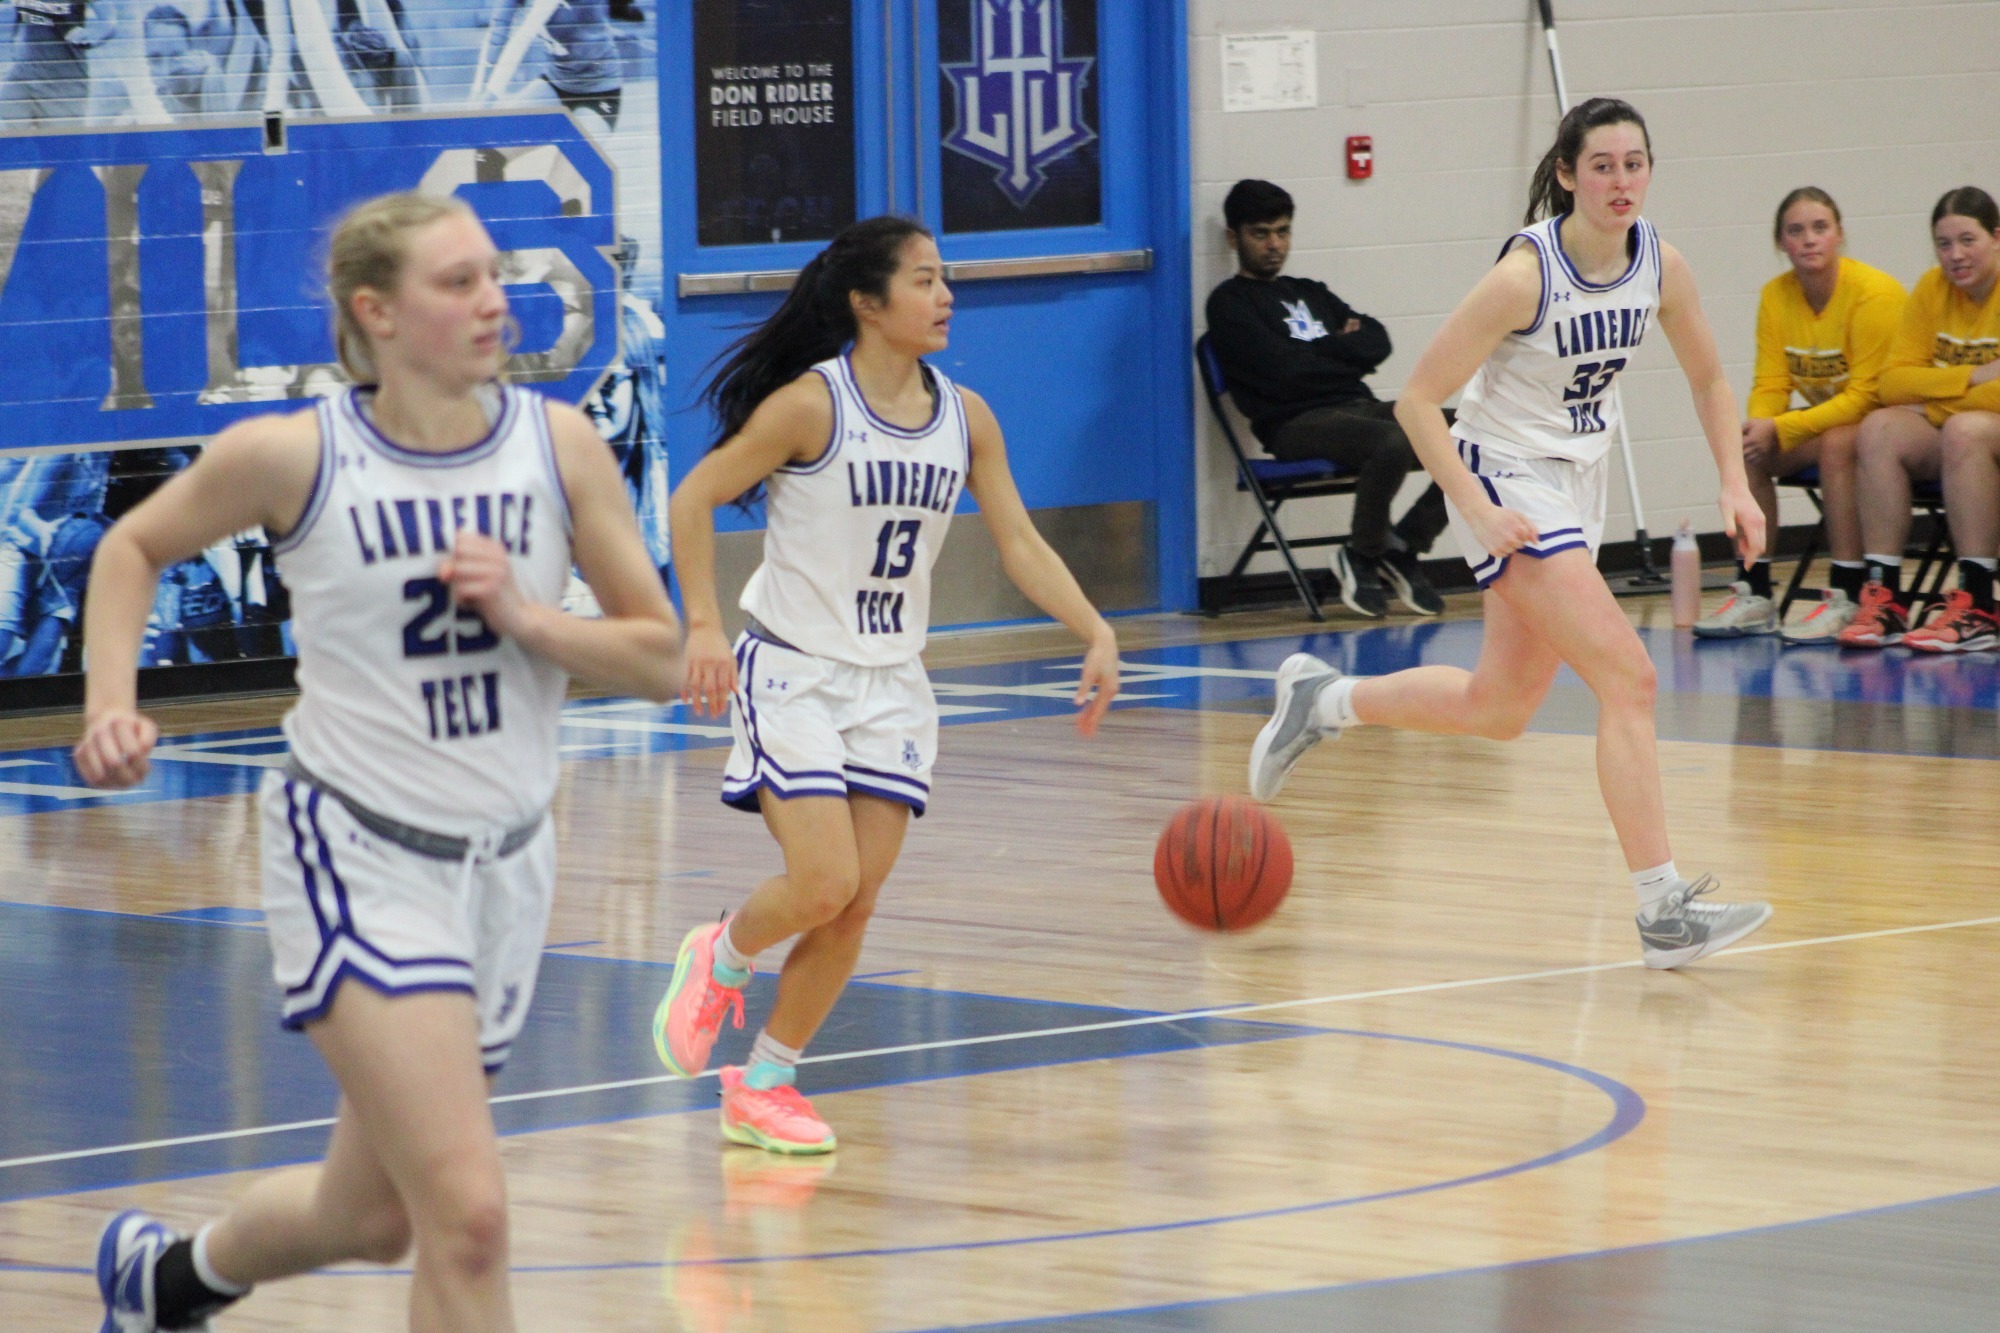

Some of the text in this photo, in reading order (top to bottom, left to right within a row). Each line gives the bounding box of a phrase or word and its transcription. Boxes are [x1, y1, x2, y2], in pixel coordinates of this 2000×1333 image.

[711, 63, 833, 80] WELCOME TO THE
[710, 82, 834, 105] DON RIDLER
[711, 105, 835, 127] FIELD HOUSE
[1563, 357, 1627, 402] 33
[847, 460, 958, 514] LAWRENCE
[870, 519, 921, 579] 13
